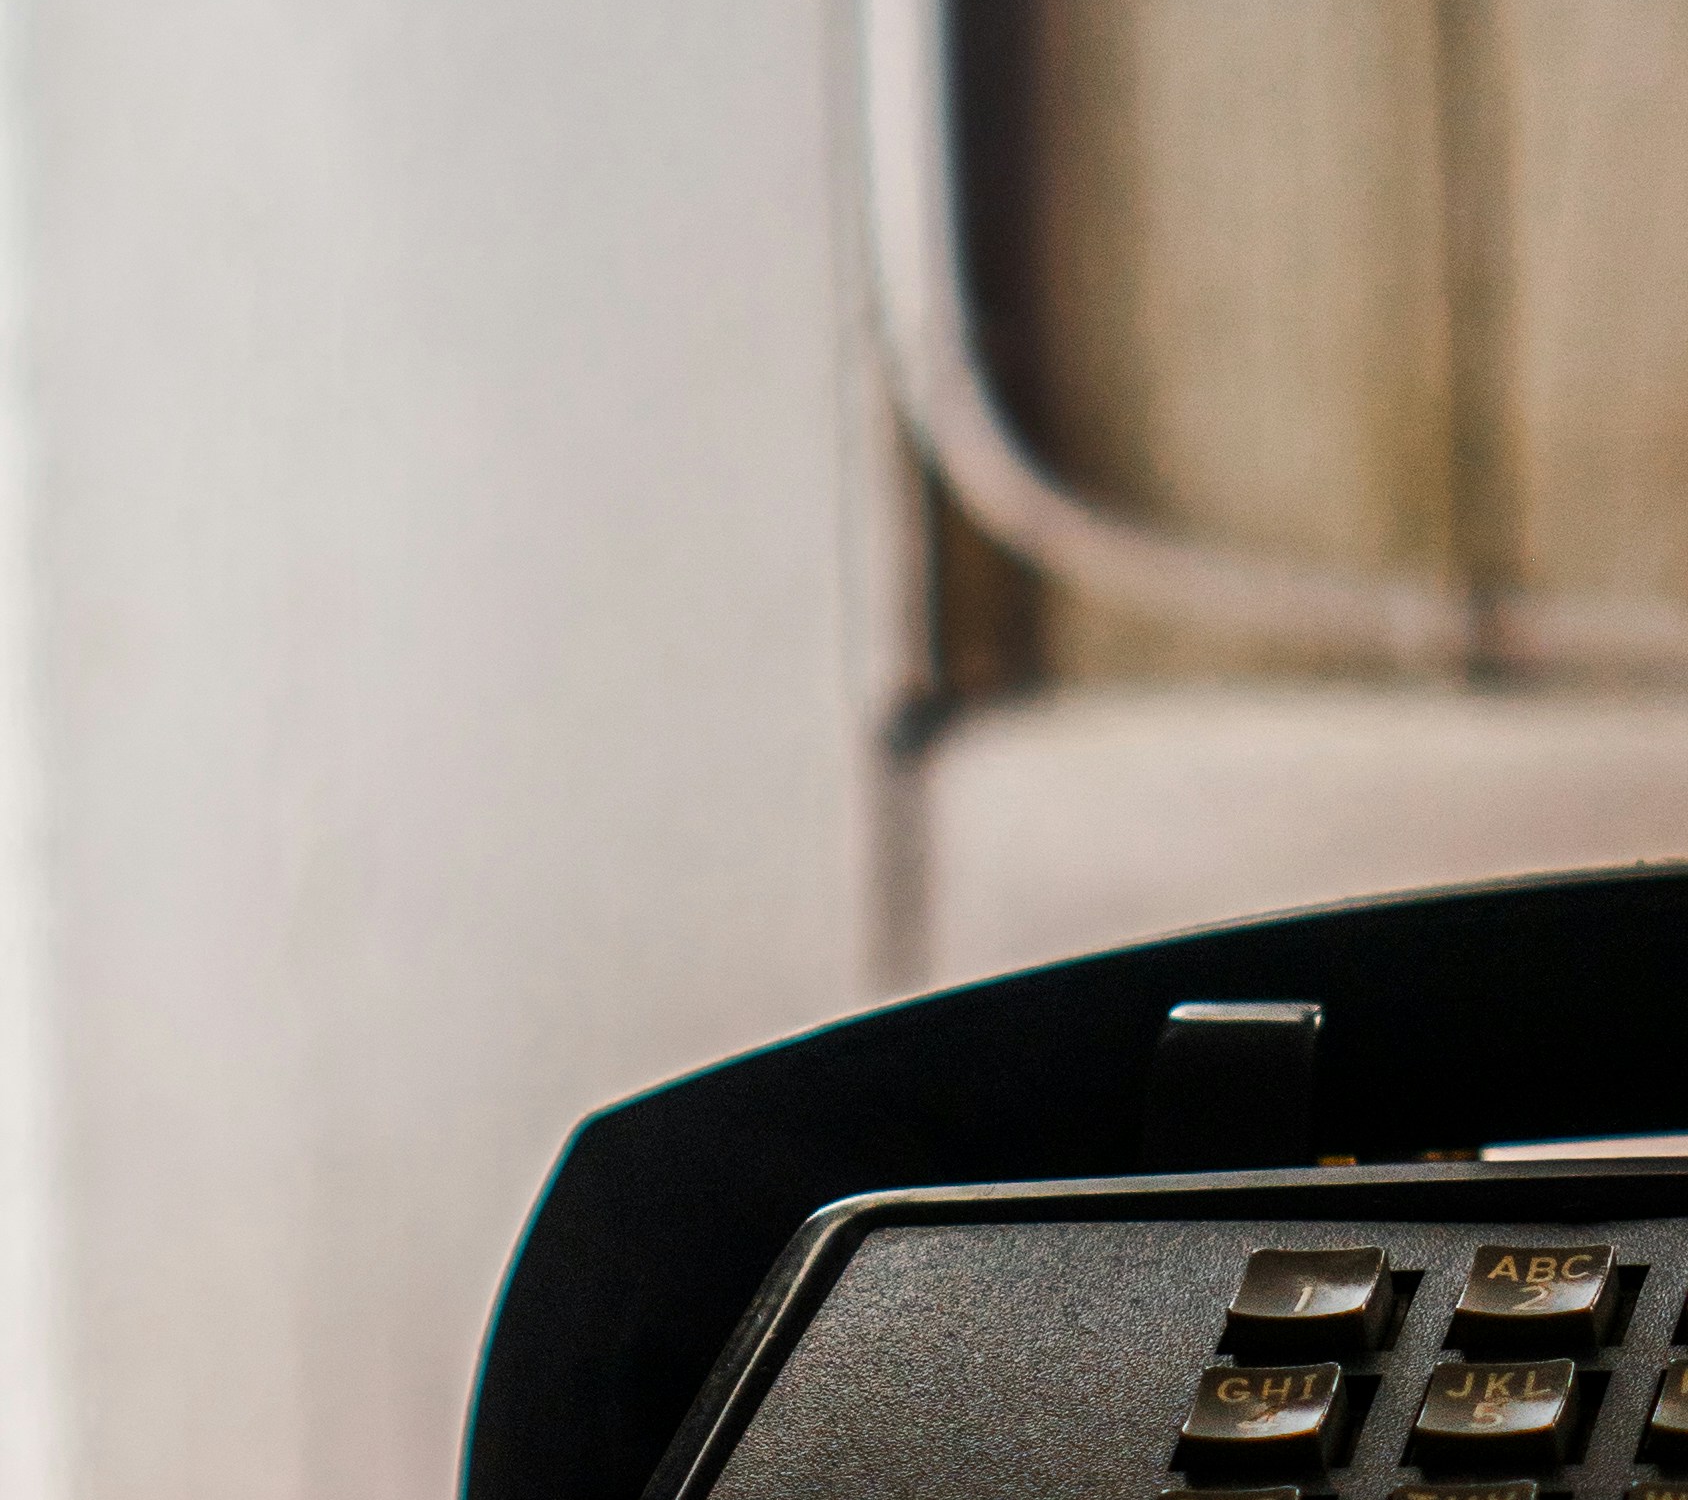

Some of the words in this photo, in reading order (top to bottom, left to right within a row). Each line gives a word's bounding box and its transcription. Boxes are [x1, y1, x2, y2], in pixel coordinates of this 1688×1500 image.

[1487, 1253, 1593, 1285] ABC
[1293, 1277, 1314, 1313] 1
[1511, 1284, 1551, 1312] 2
[1215, 1373, 1319, 1403] GHI
[1444, 1370, 1552, 1400] JKL
[1472, 1399, 1508, 1430] 5
